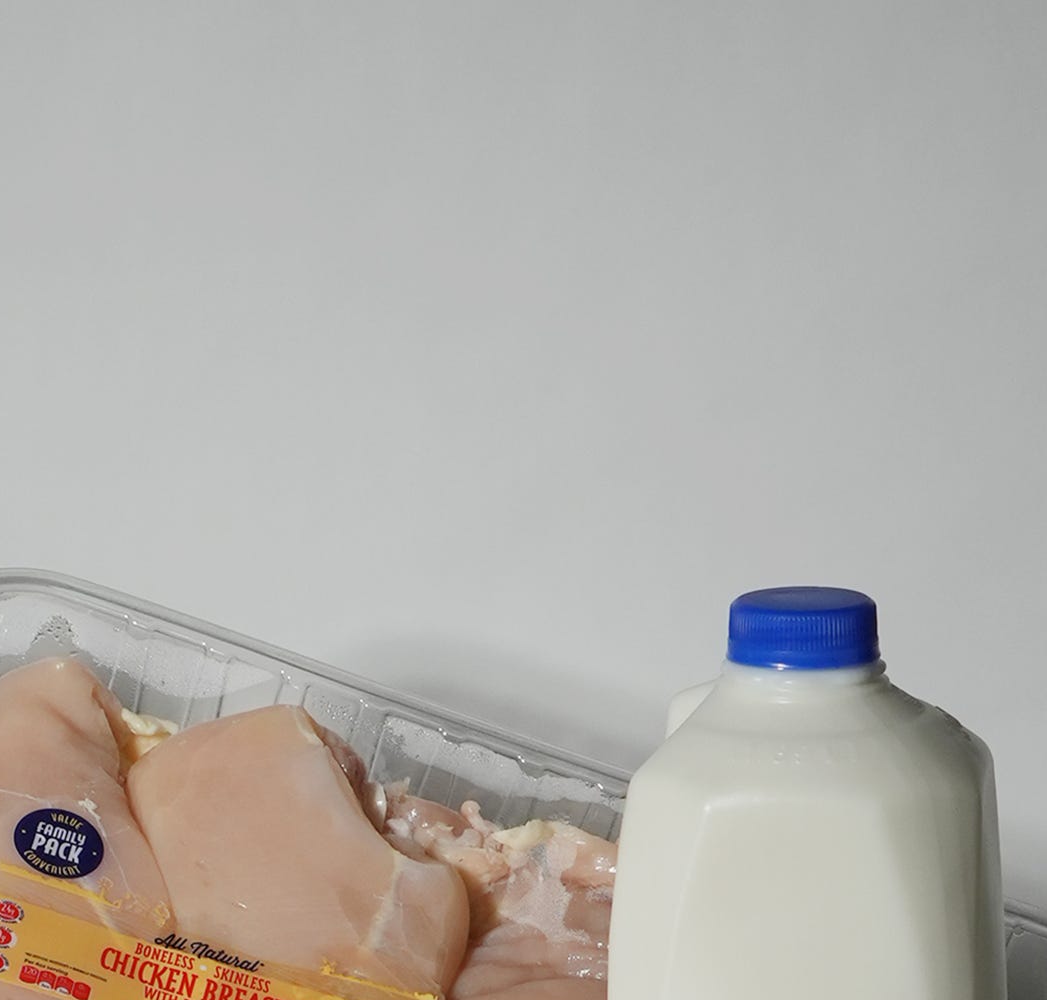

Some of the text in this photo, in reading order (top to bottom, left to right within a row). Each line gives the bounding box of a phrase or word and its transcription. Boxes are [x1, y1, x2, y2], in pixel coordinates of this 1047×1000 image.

[36, 821, 87, 846] FAMILY
[51, 812, 84, 830] VALUE
[23, 849, 81, 876] CONVENIENT
[31, 833, 84, 864] PACK
[134, 942, 196, 971] BONELESS
[154, 934, 187, 952] All
[99, 947, 199, 998] CHICKEN
[213, 965, 272, 994] SKINLESS
